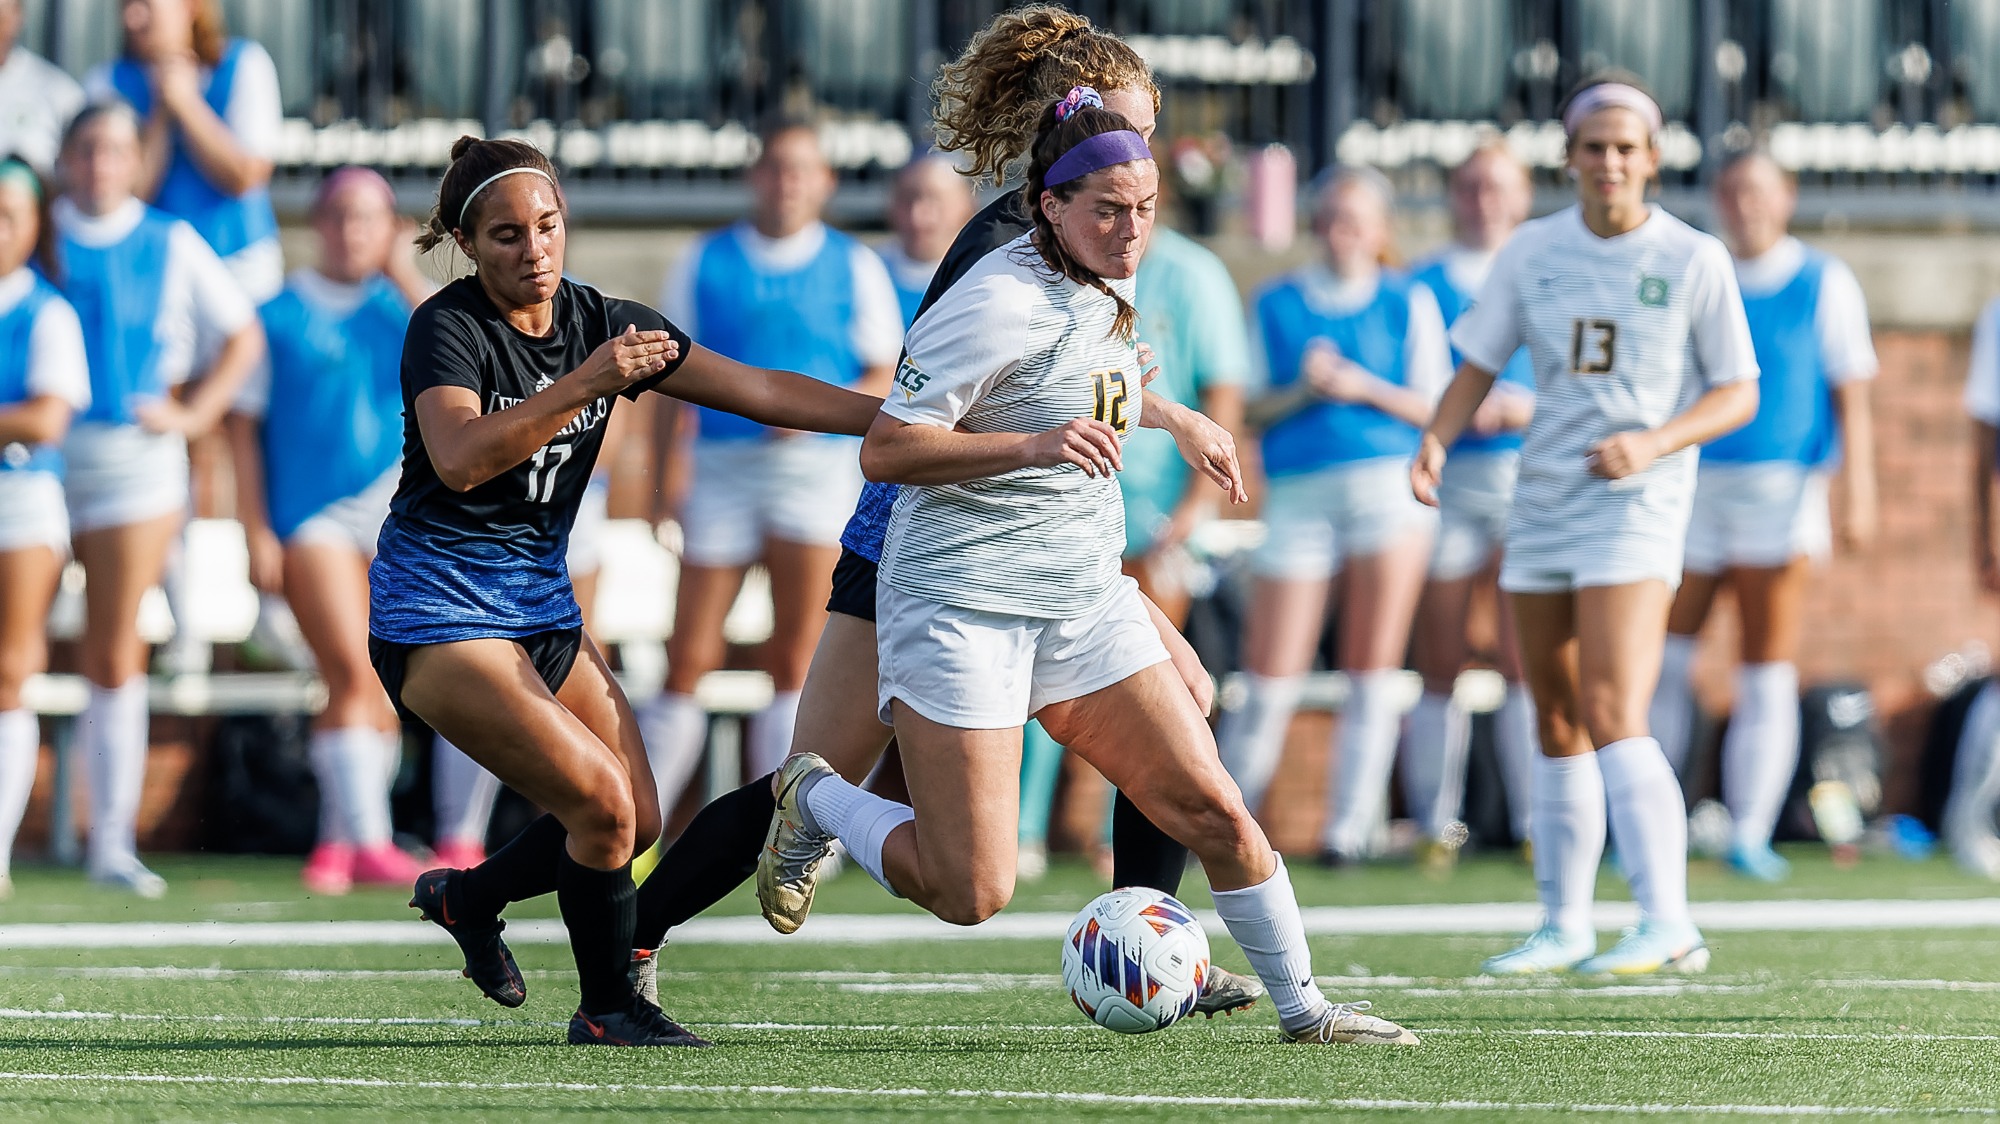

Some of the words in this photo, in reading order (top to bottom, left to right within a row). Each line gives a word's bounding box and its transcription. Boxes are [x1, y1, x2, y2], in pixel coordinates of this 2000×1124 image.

[1570, 317, 1617, 374] 13
[1089, 368, 1129, 434] 12
[525, 443, 572, 503] 17
